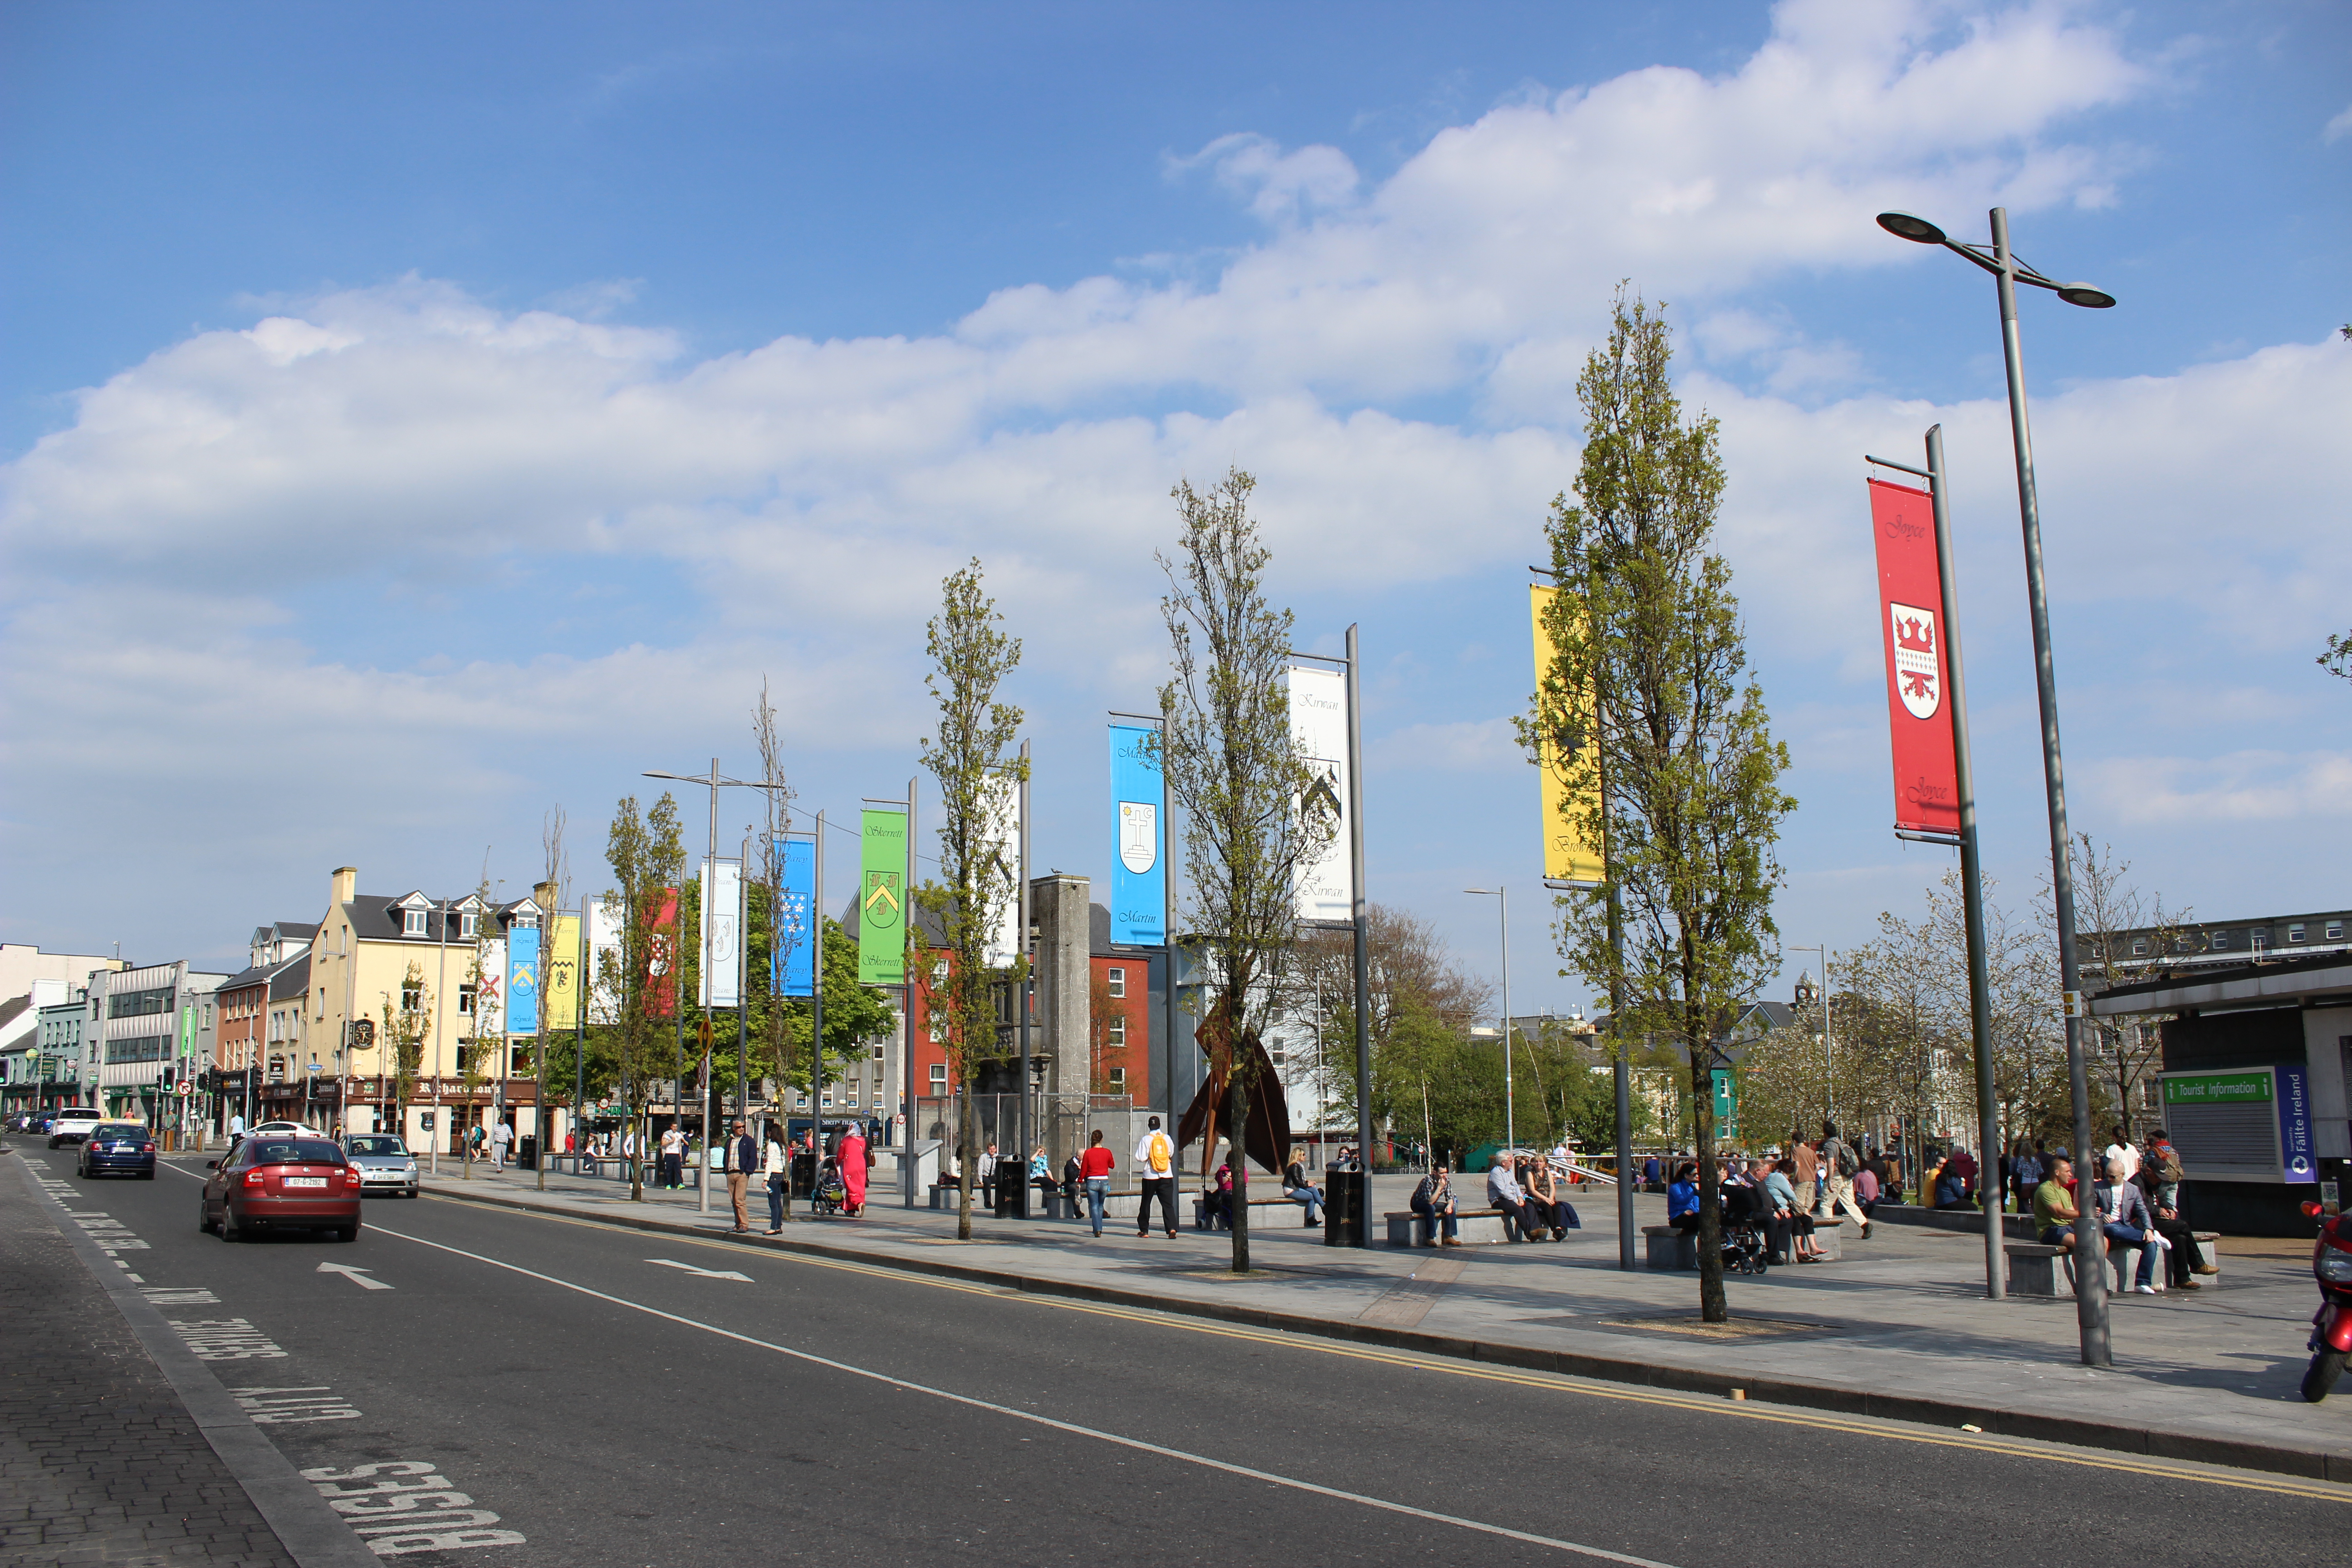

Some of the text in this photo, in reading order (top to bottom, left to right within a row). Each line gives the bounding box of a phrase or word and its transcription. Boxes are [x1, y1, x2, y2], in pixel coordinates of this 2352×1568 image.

[1885, 514, 1925, 541] Joyce
[1298, 694, 1338, 710] Kirwan
[1907, 776, 1947, 804] Joyce
[865, 825, 903, 838] Skerrett
[1301, 882, 1343, 898] Kirwan
[1118, 909, 1156, 924] Martin
[515, 937, 534, 945] Lynch
[862, 954, 900, 967] Skerrett
[2179, 1083, 2205, 1096] Tourist
[2208, 1080, 2256, 1098] Information
[2288, 1074, 2307, 1152] Fáilte Ireland
[137, 1287, 527, 1555] BUSES CITY SERVICE ONLY
